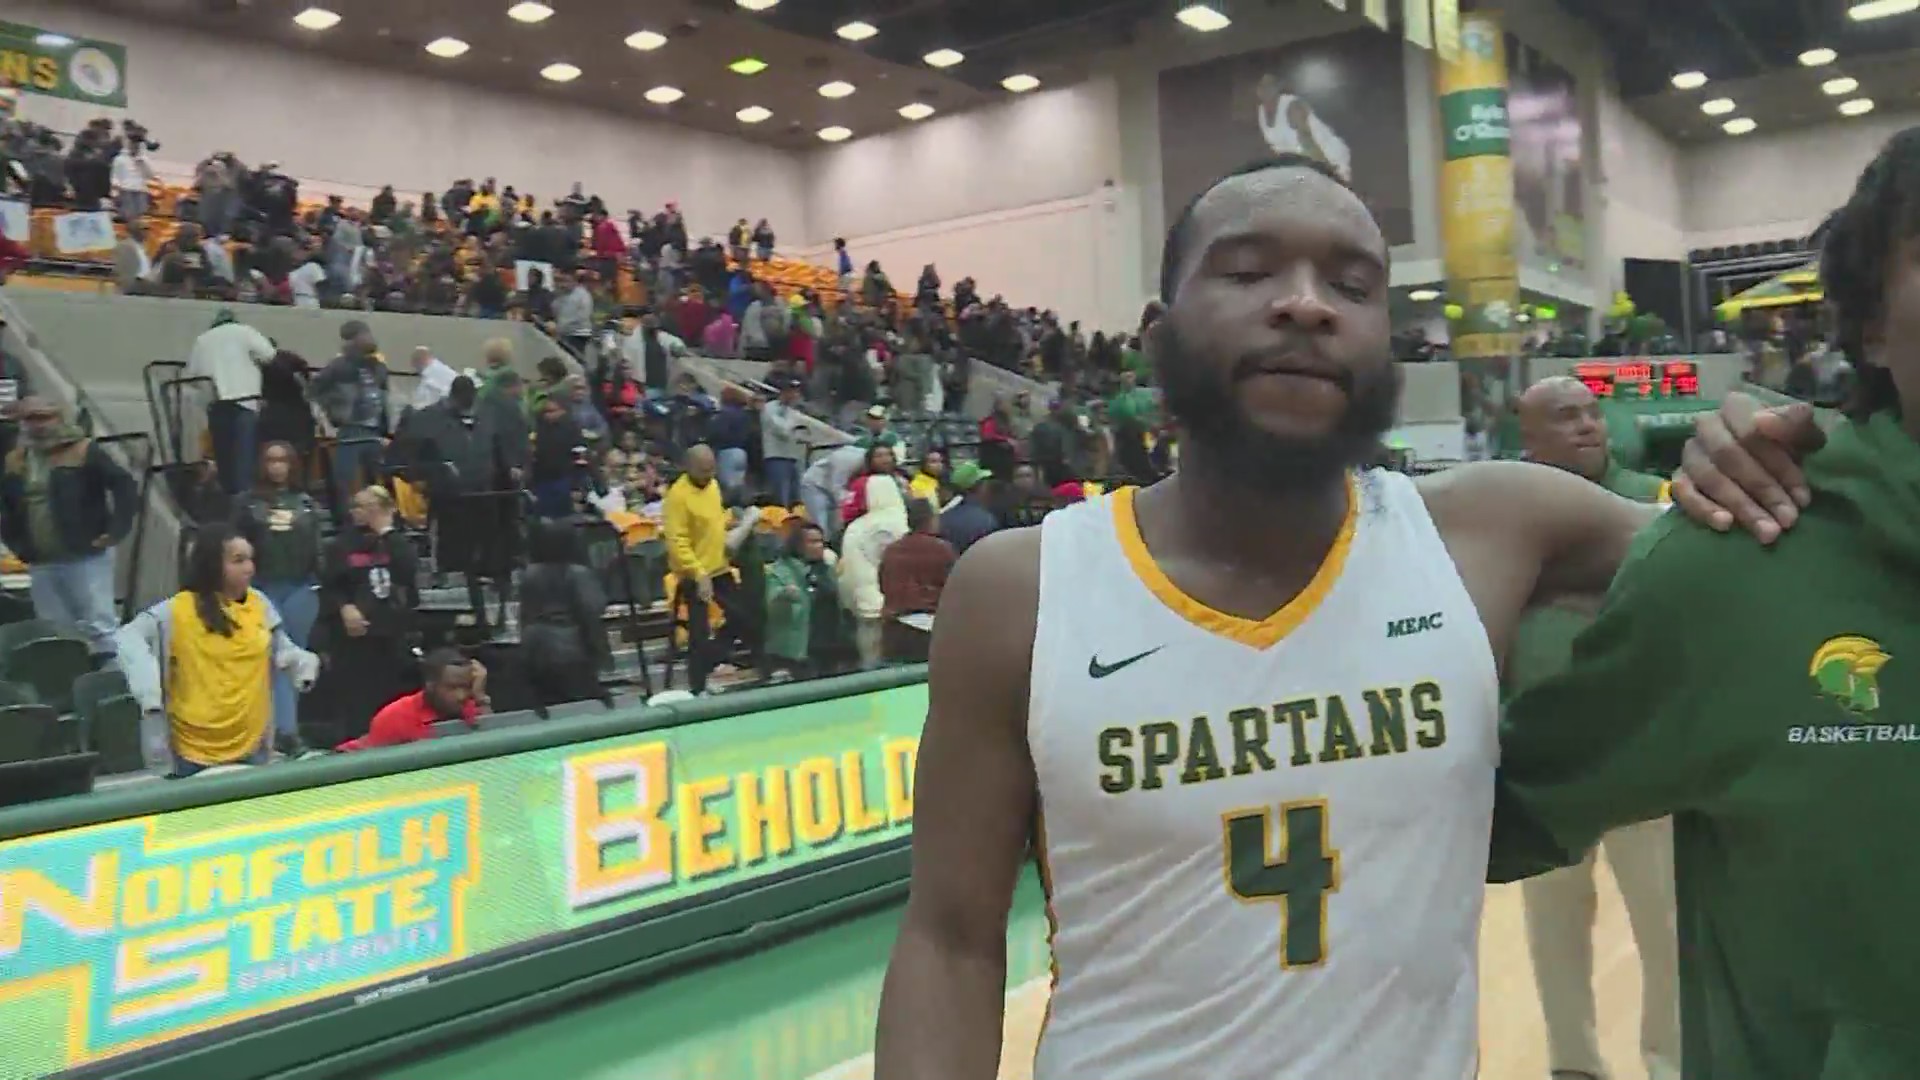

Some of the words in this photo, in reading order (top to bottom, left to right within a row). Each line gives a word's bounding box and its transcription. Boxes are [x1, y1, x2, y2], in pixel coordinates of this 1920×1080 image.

[1386, 612, 1444, 638] MEAC
[1097, 680, 1447, 795] SPARTANS
[1787, 724, 1920, 743] BASKETBAL
[0, 813, 449, 956] NORFOLK
[563, 736, 919, 911] BEHOLD
[1221, 797, 1340, 971] 4
[108, 870, 438, 1025] STATE
